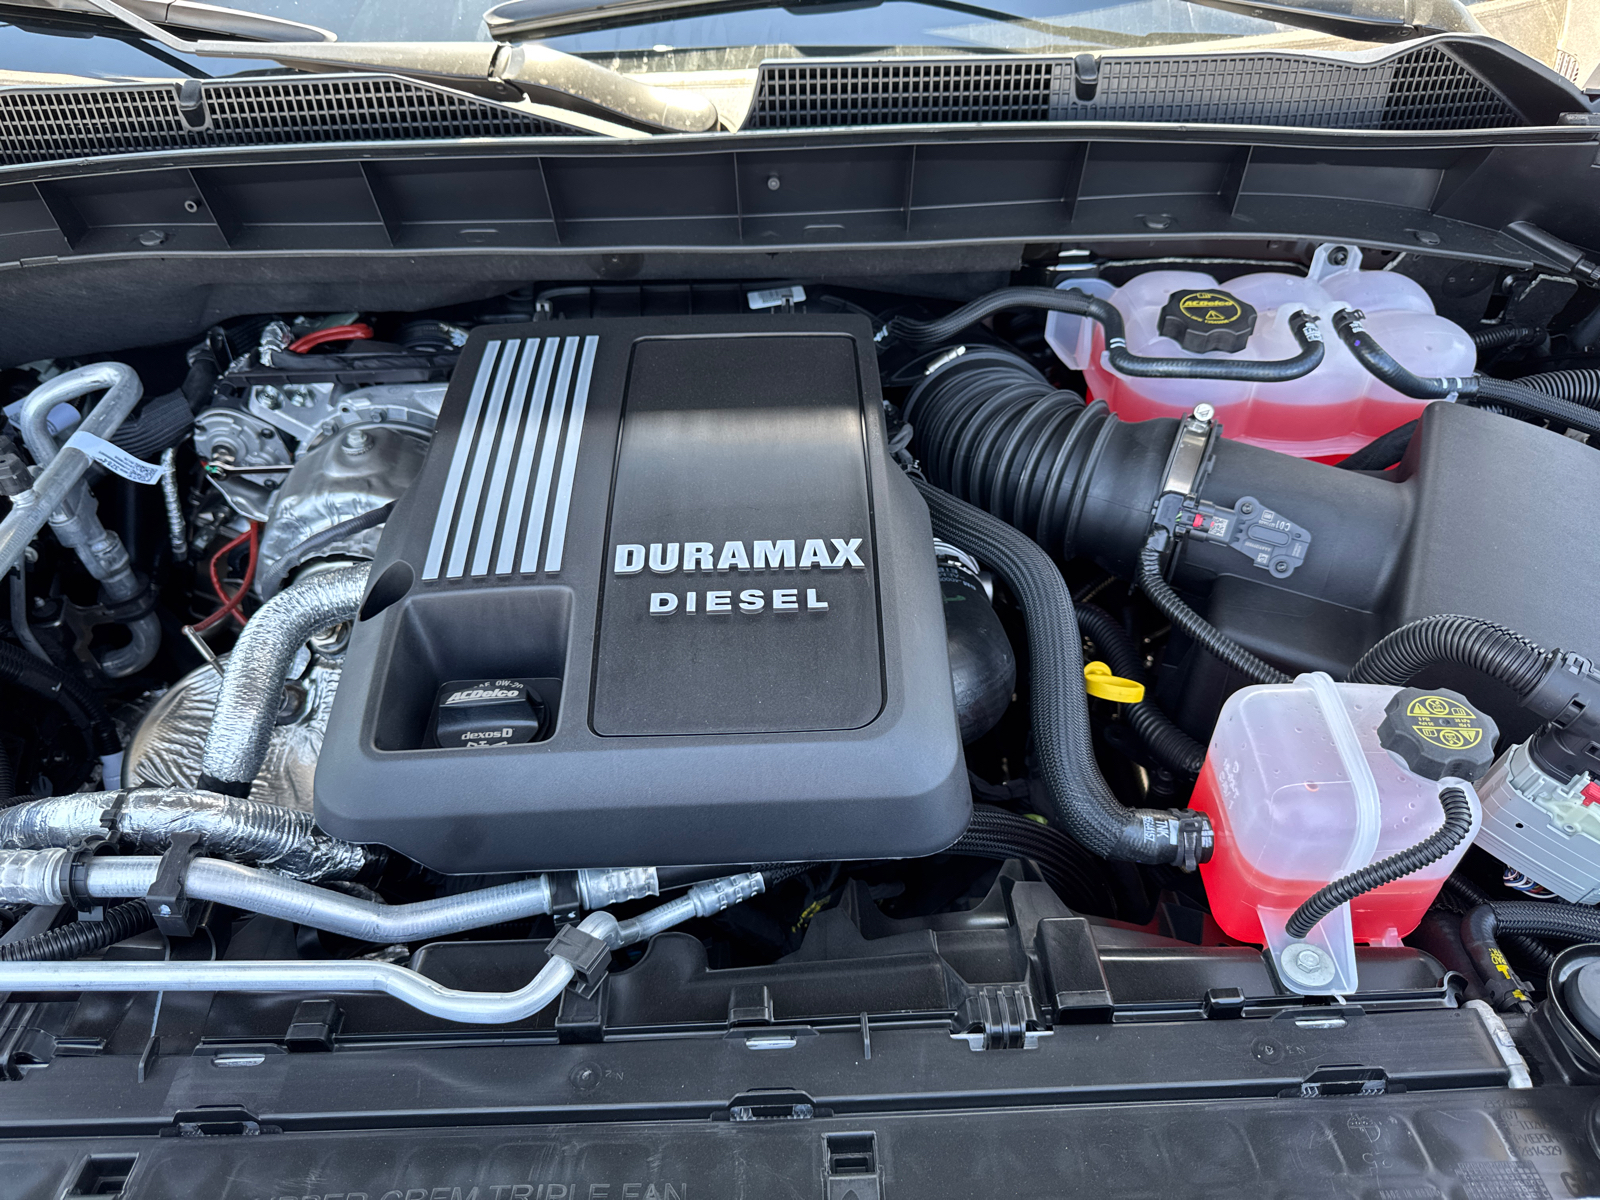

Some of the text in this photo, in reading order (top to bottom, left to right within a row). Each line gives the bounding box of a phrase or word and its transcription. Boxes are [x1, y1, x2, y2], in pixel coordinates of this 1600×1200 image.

[1182, 300, 1235, 308] ACDelco
[613, 537, 866, 576] DURAMAX
[649, 588, 830, 616] DIESEL
[445, 688, 519, 704] ACDelco
[1155, 820, 1170, 838] TNK
